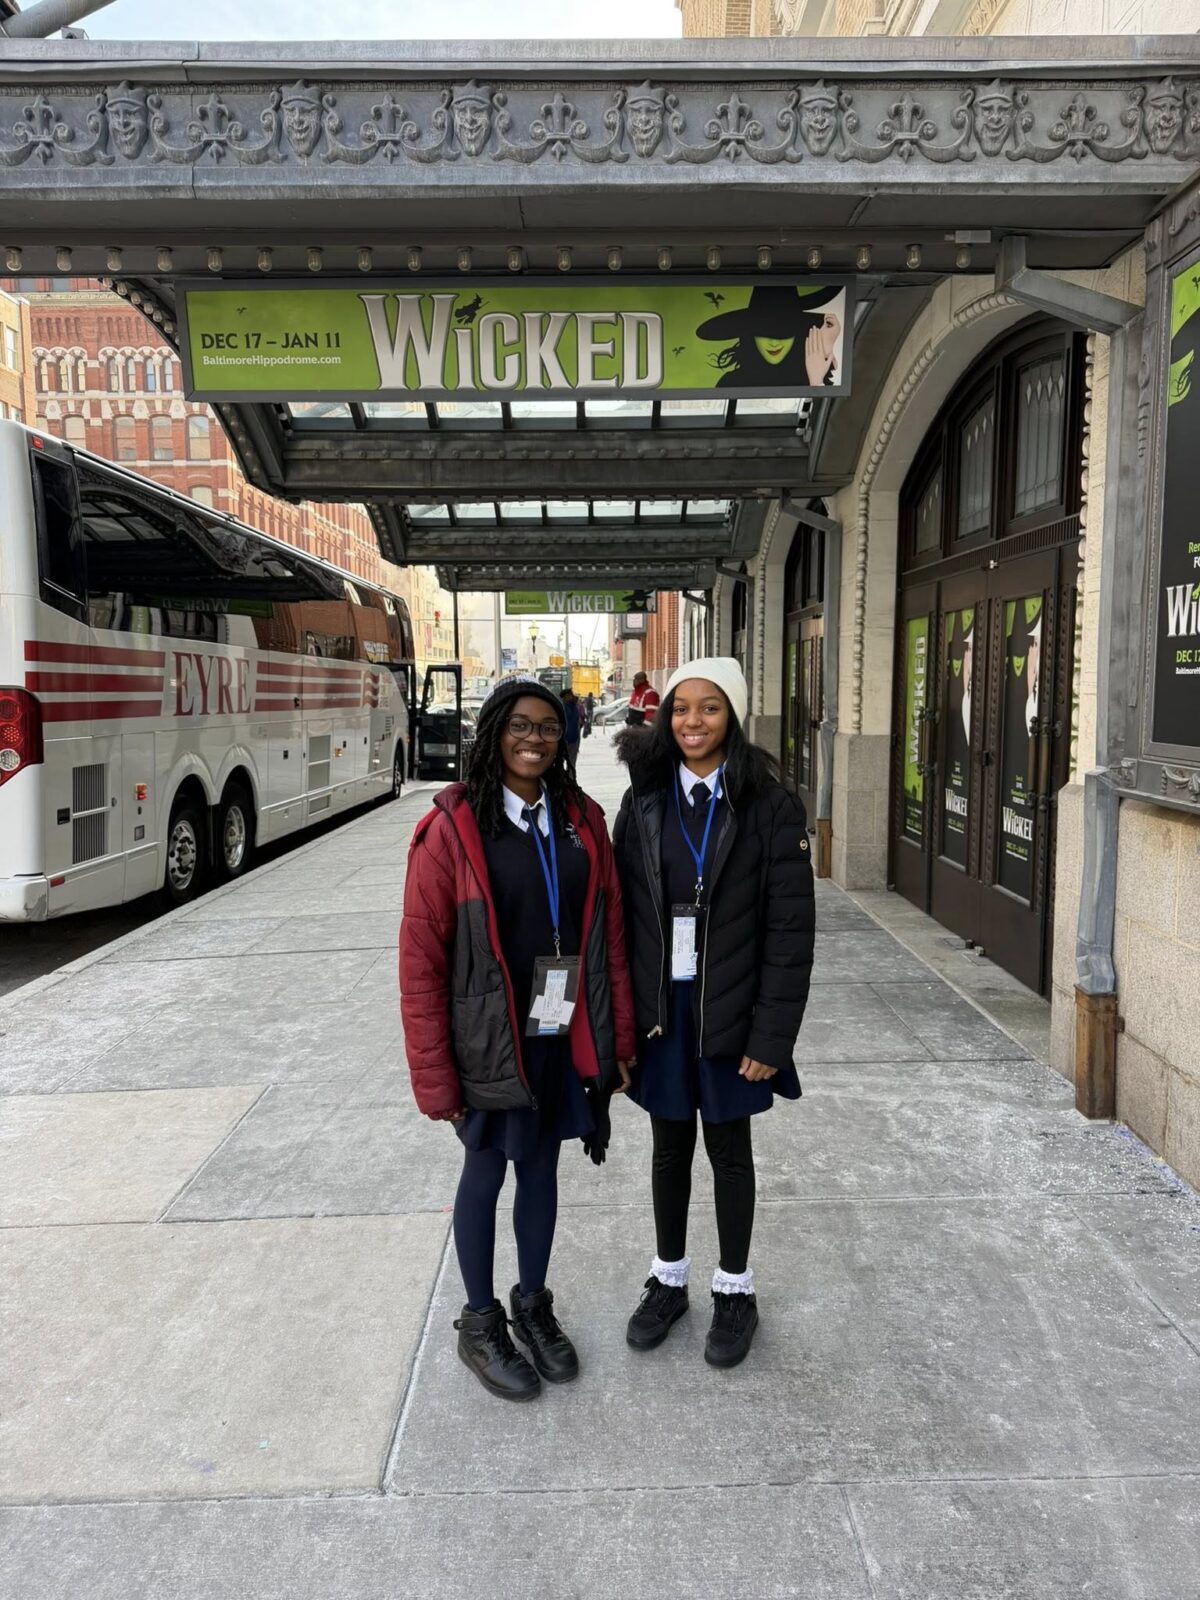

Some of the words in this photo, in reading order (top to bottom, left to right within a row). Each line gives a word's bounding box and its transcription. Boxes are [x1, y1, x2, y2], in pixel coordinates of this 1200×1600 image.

[200, 333, 238, 349] DEC
[244, 332, 262, 349] 17
[281, 332, 319, 348] JAN
[325, 332, 341, 348] 11
[202, 354, 342, 367] BaltimoreHippodrome.com
[1166, 583, 1200, 637] Wi
[1176, 650, 1192, 663] DEC
[172, 651, 252, 716] EYRE
